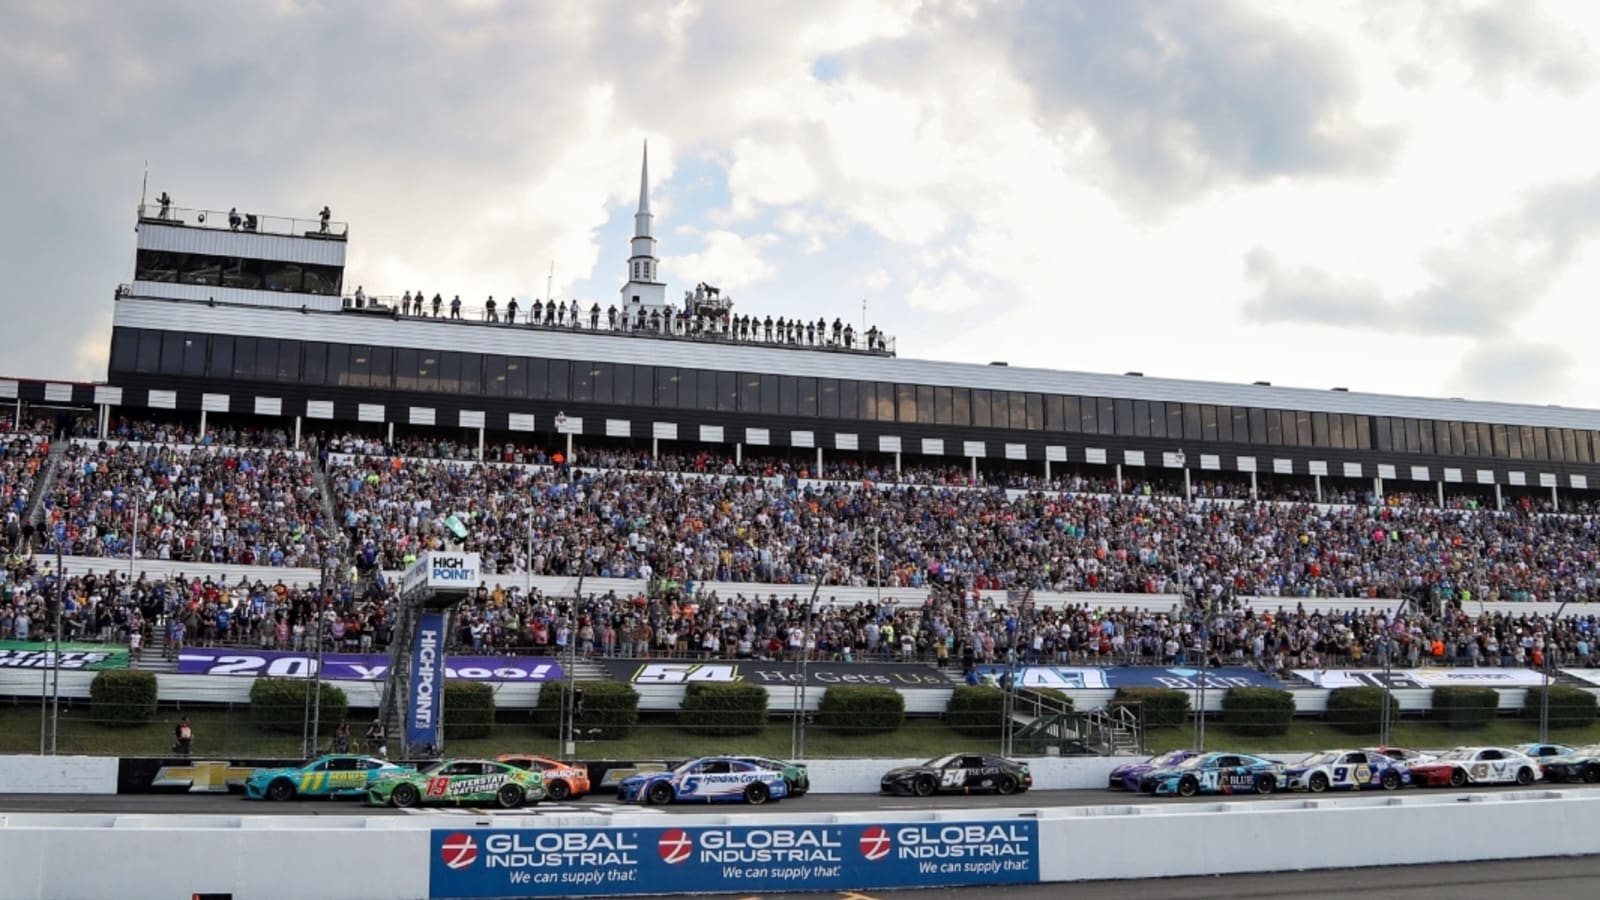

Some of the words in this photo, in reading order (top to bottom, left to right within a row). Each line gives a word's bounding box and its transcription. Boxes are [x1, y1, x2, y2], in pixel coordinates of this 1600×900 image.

[433, 557, 463, 568] HIGH
[433, 569, 470, 580] POINT
[208, 656, 318, 677] 20
[350, 664, 553, 679] Yoo!
[632, 663, 741, 683] 54
[415, 630, 437, 724] HIGHPOINT
[814, 671, 891, 684] Gets
[942, 768, 967, 787] 54
[1202, 771, 1219, 789] 47
[1332, 767, 1349, 782] 9
[425, 775, 450, 797] 19
[681, 774, 702, 795] 5
[486, 832, 639, 853] GLOBAL
[699, 830, 842, 849] GLOBAL
[897, 825, 1029, 845] GLOBAL
[700, 849, 842, 863] INDUSTRIAL
[898, 843, 1029, 859] INDUSTRIAL
[486, 852, 639, 868] INDUSTRIAL
[919, 862, 938, 874] We
[940, 862, 962, 872] can
[964, 859, 1003, 875] supply
[509, 870, 531, 884] We
[533, 871, 558, 884] can
[561, 869, 605, 884] supply
[722, 866, 743, 878] We
[745, 868, 768, 878] can
[771, 865, 811, 880] supply
